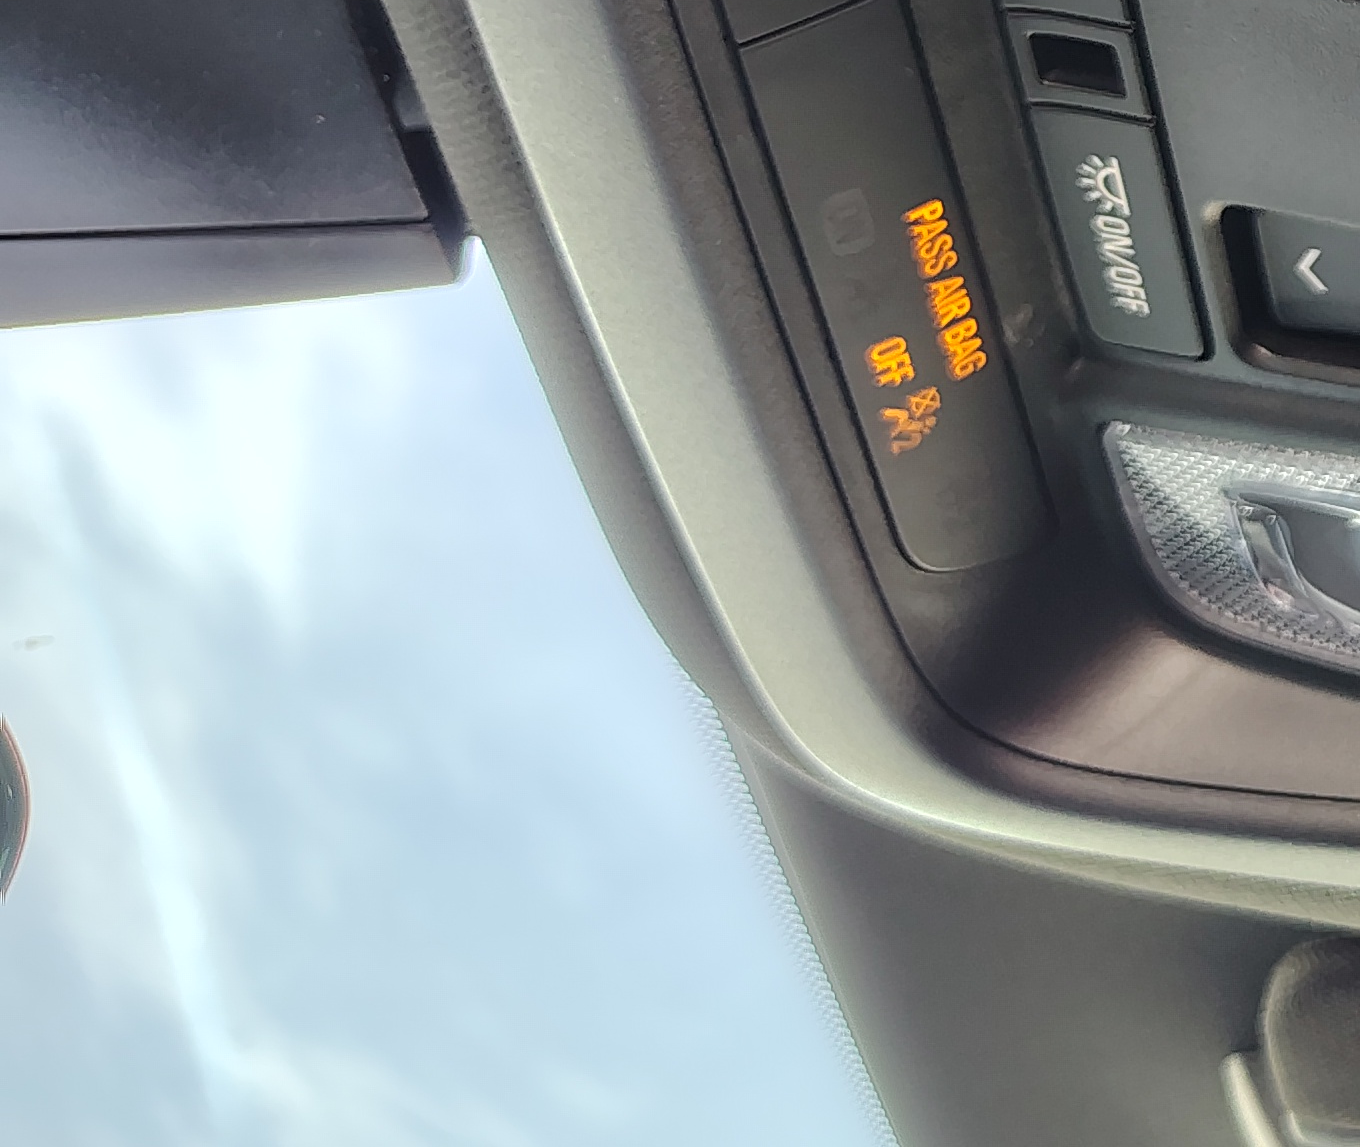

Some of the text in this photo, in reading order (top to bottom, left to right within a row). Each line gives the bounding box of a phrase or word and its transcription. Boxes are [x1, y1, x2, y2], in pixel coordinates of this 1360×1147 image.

[902, 199, 986, 380] PASS AIR BAG
[1091, 216, 1151, 317] ON/OFF
[866, 337, 915, 386] OFF
